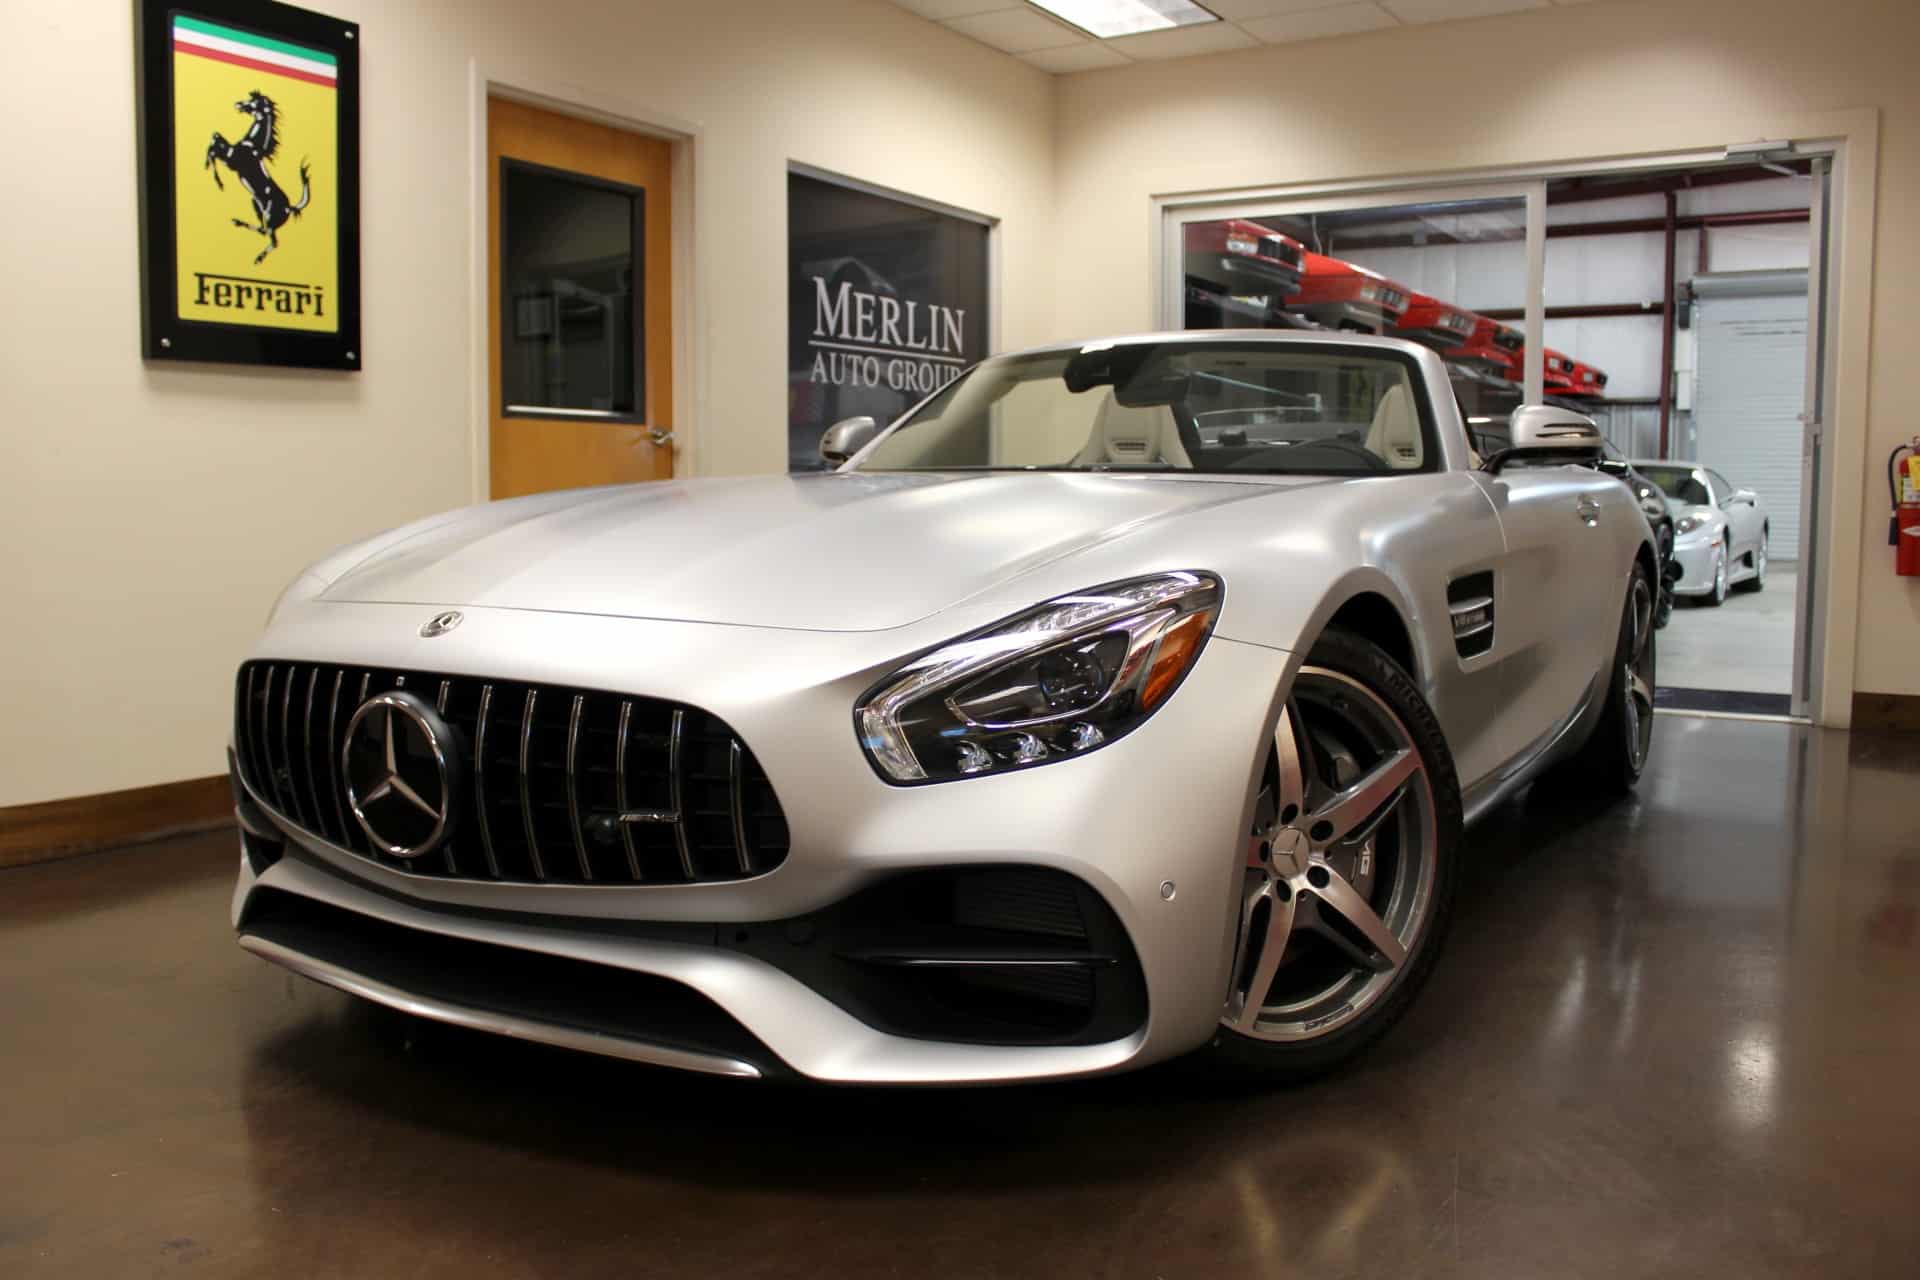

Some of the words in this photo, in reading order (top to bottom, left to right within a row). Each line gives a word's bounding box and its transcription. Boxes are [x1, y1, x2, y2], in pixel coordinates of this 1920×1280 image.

[194, 272, 324, 316] Ferrari
[812, 276, 966, 354] MERLIN
[810, 351, 881, 387] AUTO
